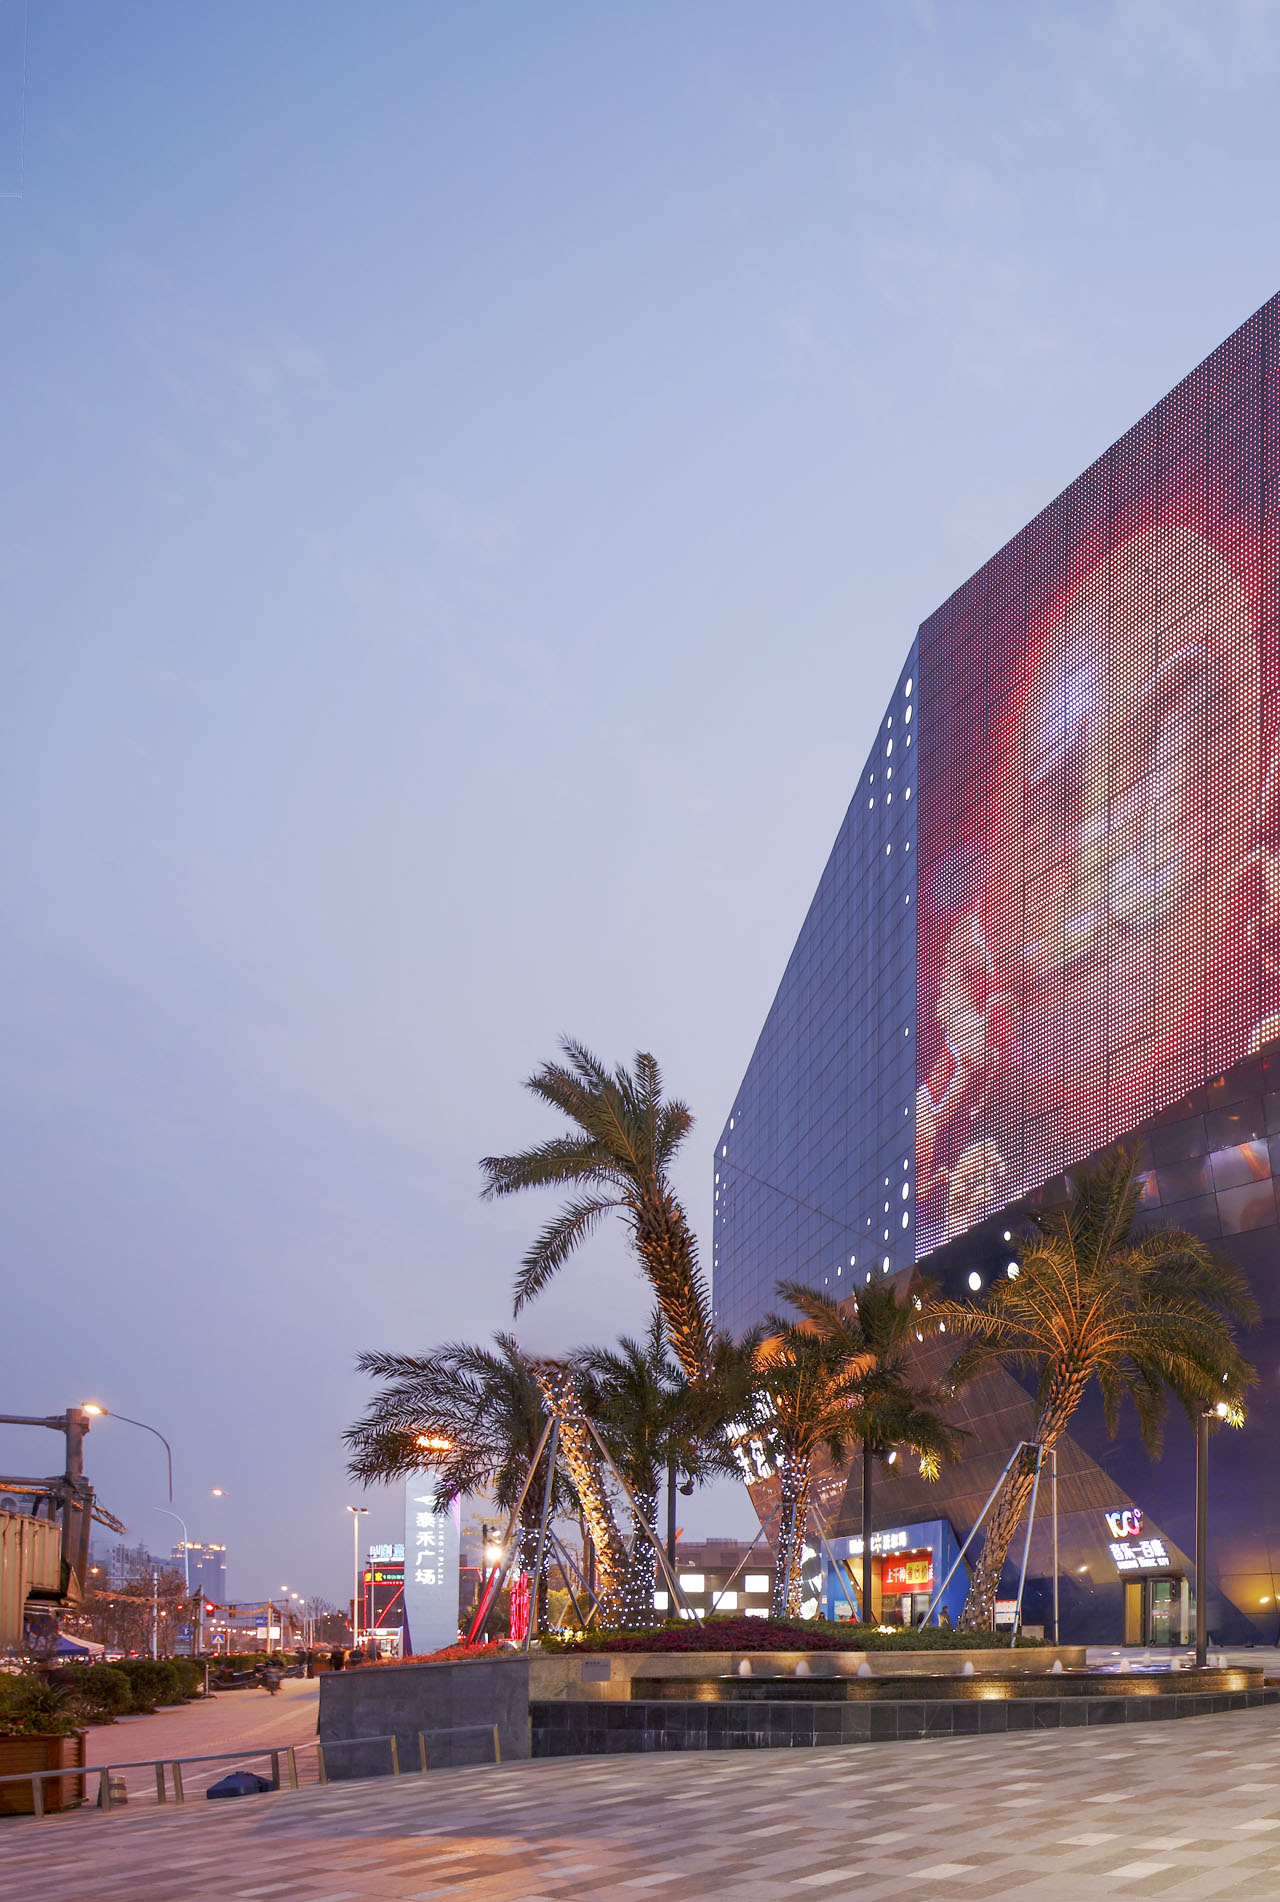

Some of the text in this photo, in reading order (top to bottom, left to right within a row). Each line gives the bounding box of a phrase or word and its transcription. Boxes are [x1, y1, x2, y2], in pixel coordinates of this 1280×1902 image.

[415, 1512, 436, 1585] 泰禾广场
[437, 1556, 445, 1585] PLAZA
